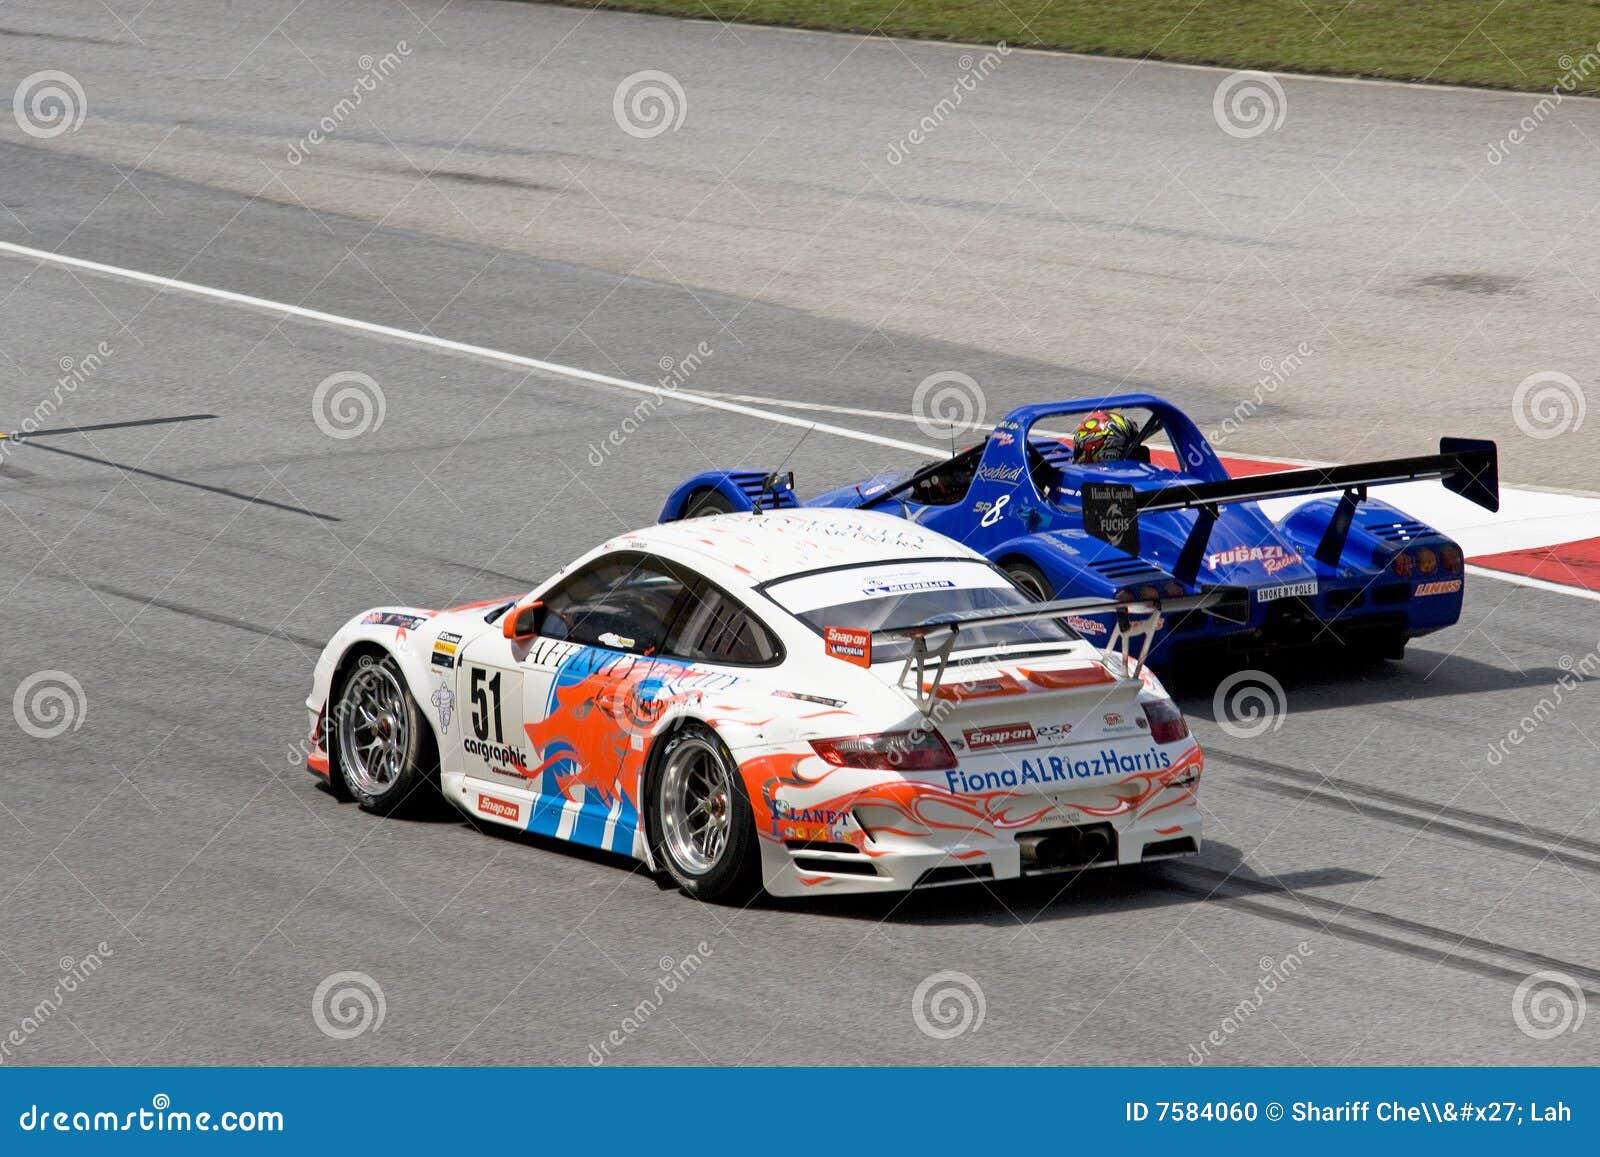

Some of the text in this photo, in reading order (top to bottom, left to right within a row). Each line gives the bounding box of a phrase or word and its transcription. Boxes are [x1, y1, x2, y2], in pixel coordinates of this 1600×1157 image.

[977, 462, 1024, 482] Radical
[1100, 518, 1129, 532] FUCHS
[1264, 552, 1303, 576] Racing
[1283, 586, 1293, 597] MY
[828, 629, 867, 646] Snap-on
[836, 645, 864, 657] MICHELIN
[471, 667, 503, 744] 51
[969, 728, 1032, 746] Snap-on
[1036, 723, 1073, 737] RSR
[464, 738, 527, 767] cargraphic
[481, 797, 517, 817] Snap-on
[771, 799, 849, 826] PLANET
